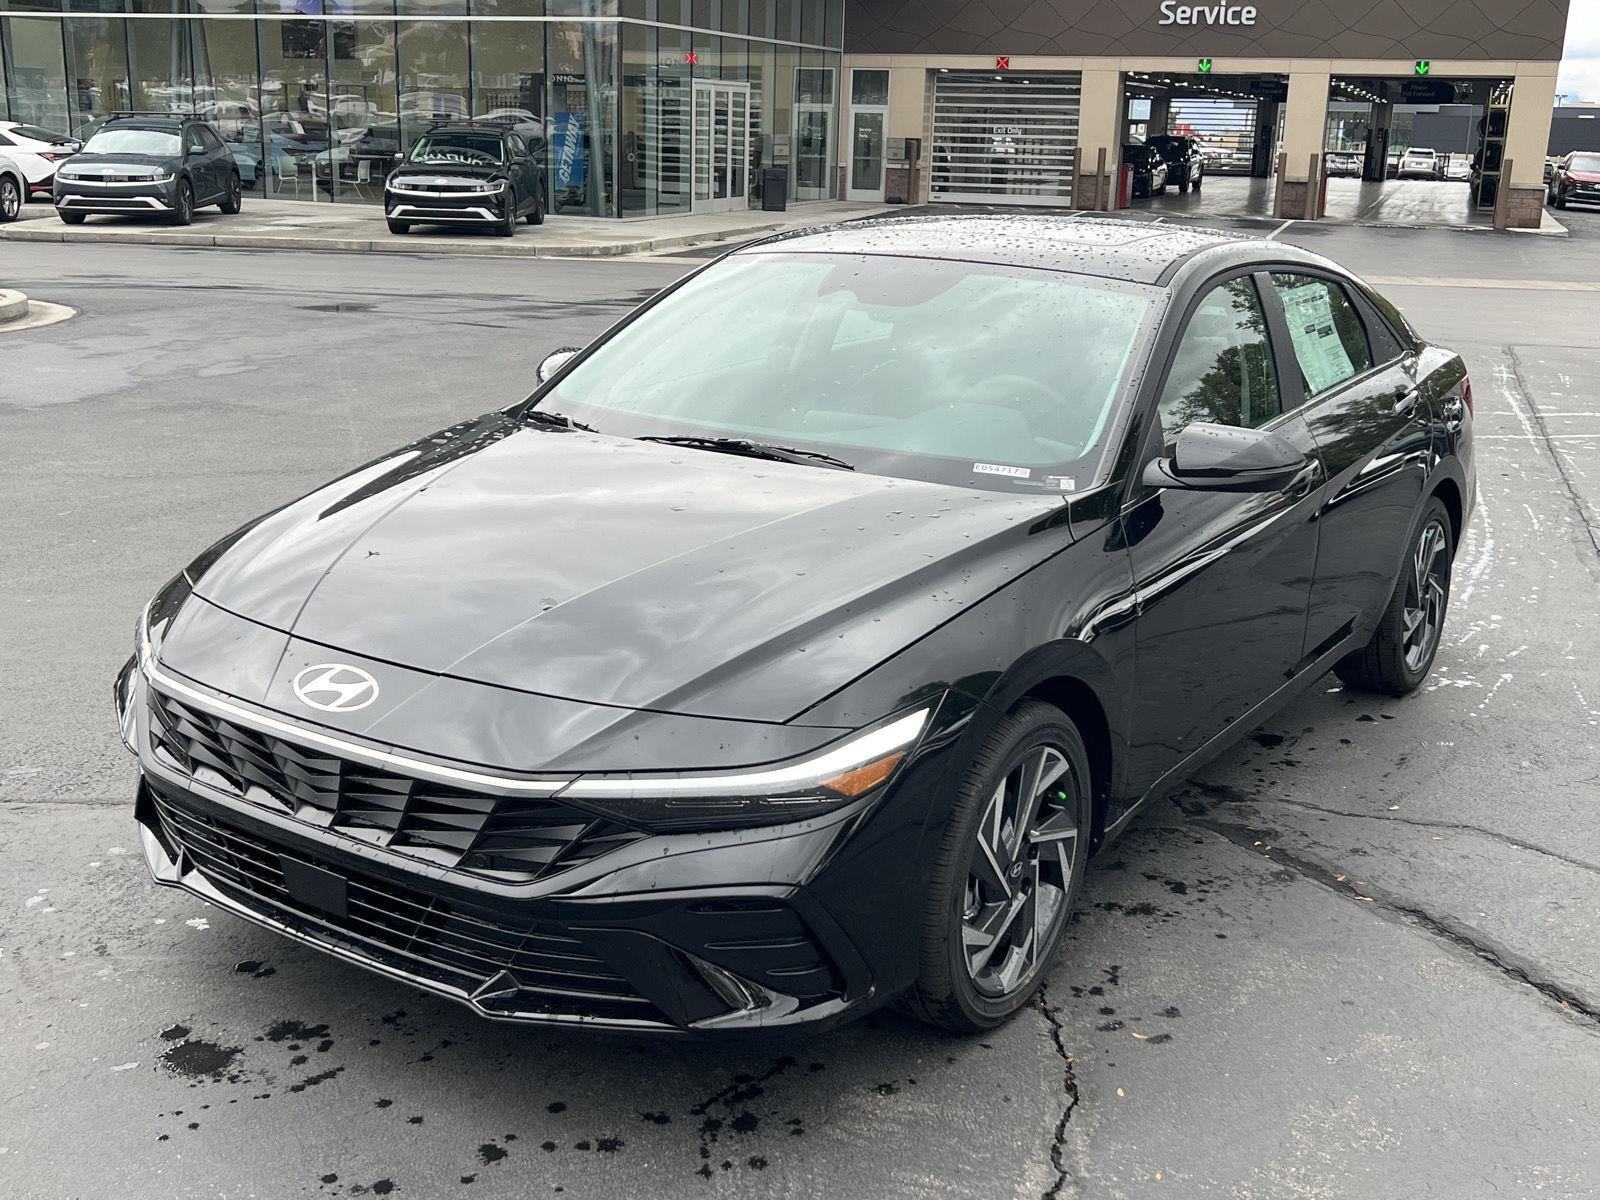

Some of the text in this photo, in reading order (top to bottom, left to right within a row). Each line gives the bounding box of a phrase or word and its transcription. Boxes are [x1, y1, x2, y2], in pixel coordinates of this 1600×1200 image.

[1158, 0, 1257, 25] Service
[1007, 127, 1022, 136] Only
[559, 113, 580, 184] GETAWAY
